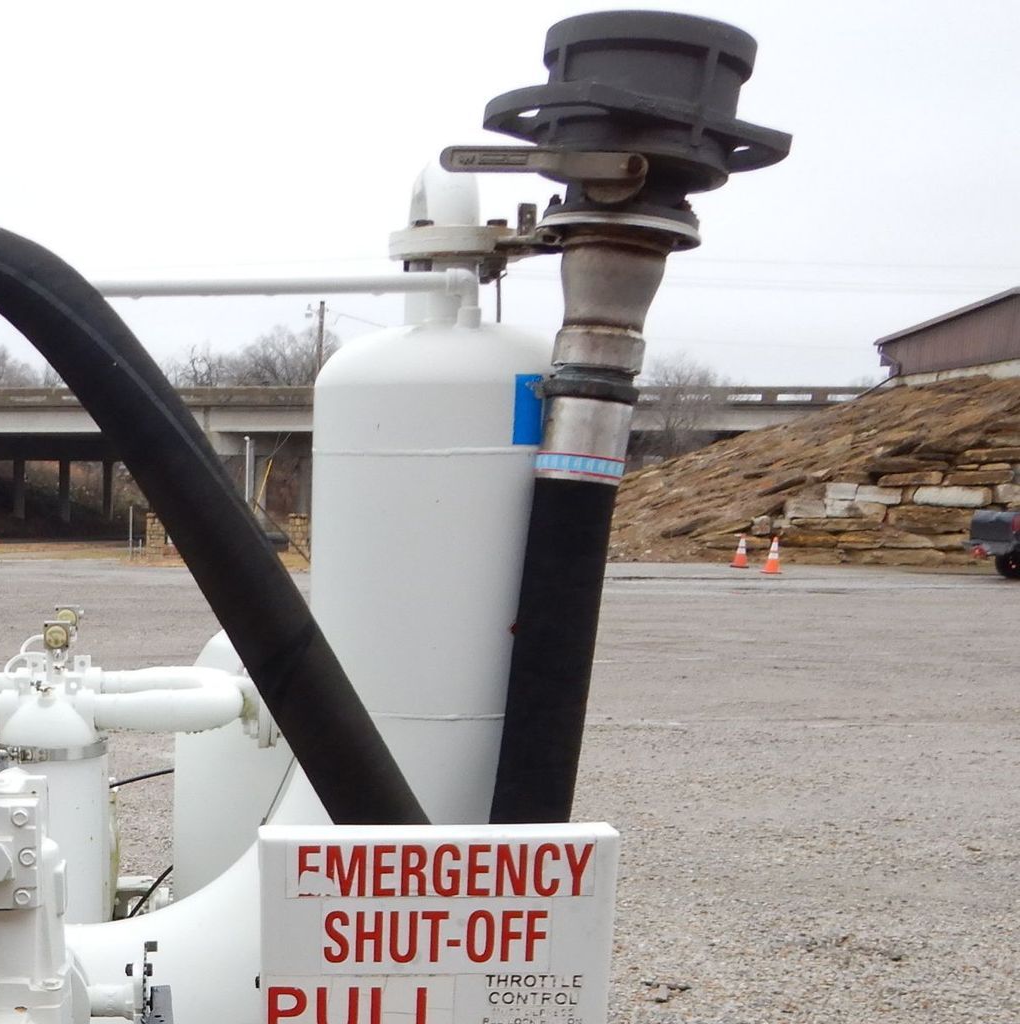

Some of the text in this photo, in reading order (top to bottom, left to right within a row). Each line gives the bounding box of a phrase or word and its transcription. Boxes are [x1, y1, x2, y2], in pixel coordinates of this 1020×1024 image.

[298, 843, 594, 898] EMERGENCY
[323, 910, 549, 964] SHUT-OFF
[485, 974, 583, 989] THROTTLE
